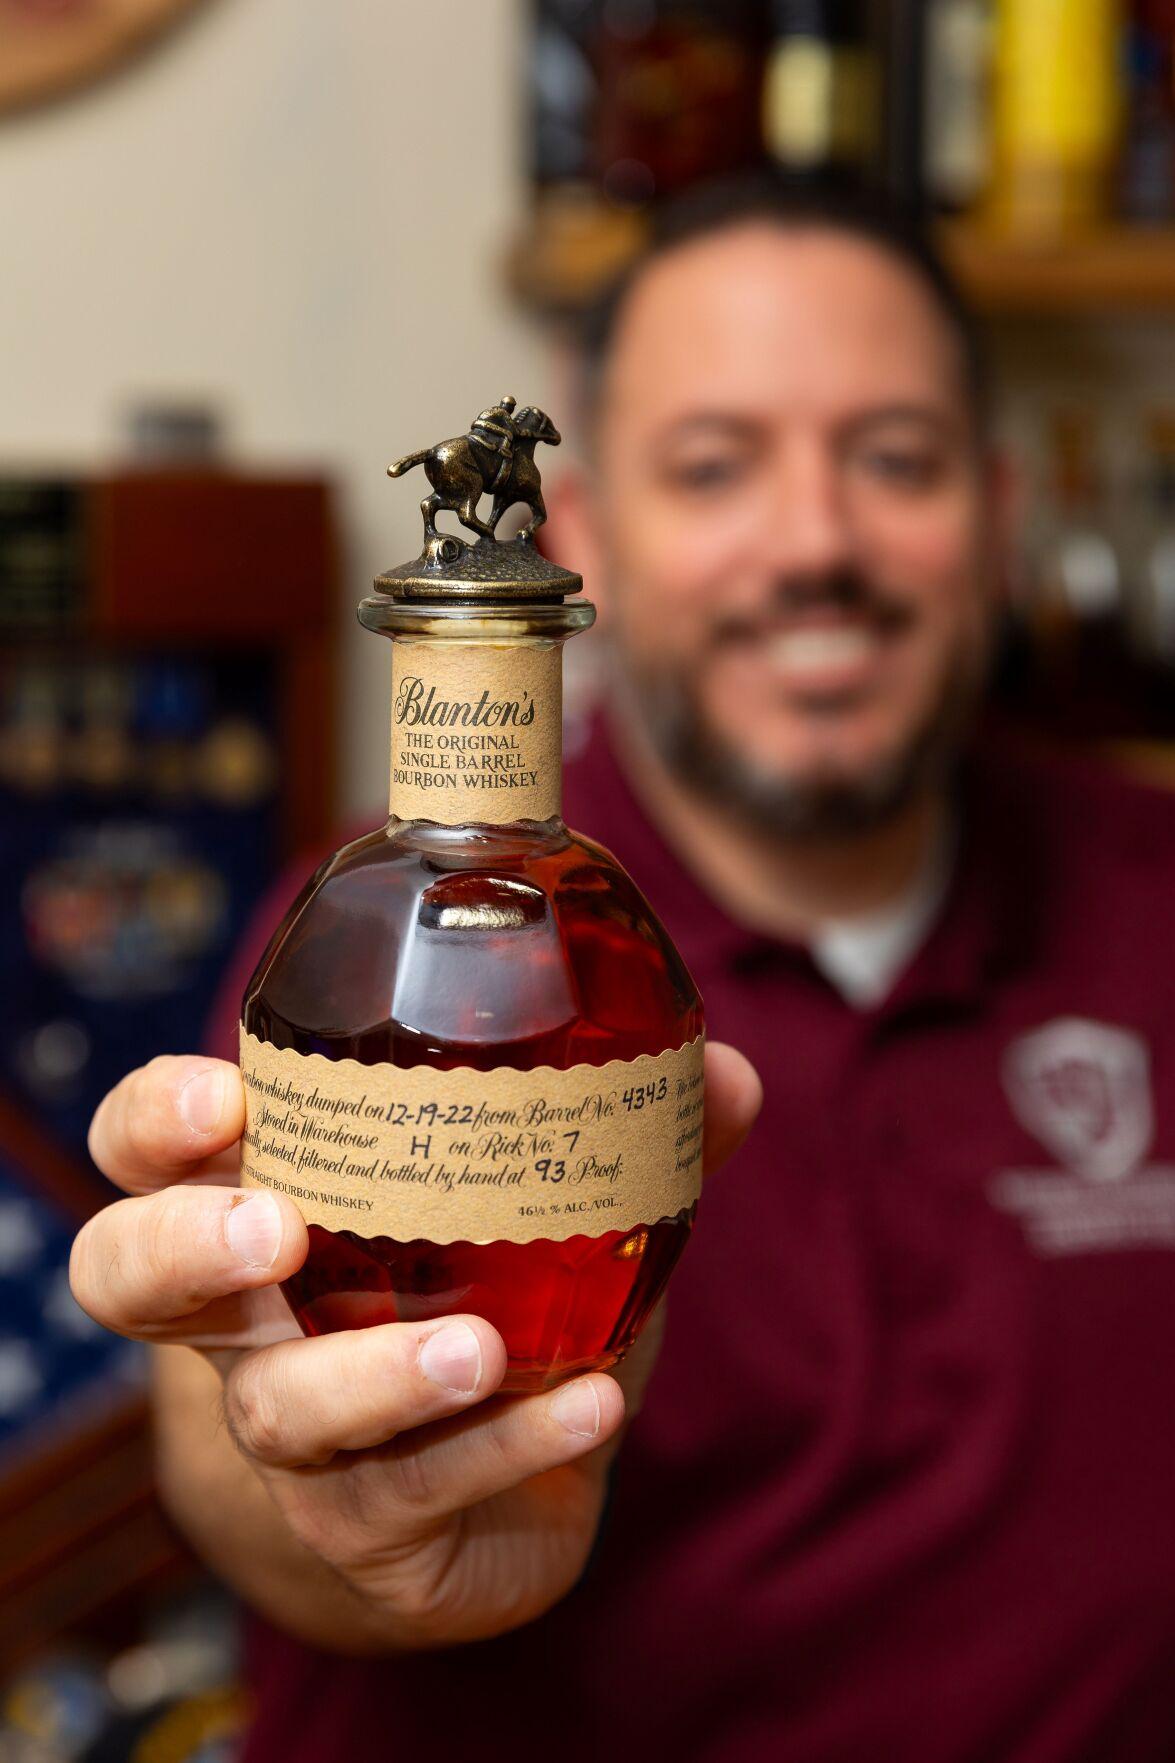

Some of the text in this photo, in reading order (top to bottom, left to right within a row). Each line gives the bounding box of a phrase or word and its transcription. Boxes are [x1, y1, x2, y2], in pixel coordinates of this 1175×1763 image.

[395, 676, 534, 726] Blanton's
[400, 752, 525, 772] SINGLE BARREL
[405, 733, 519, 753] THE ORIGINAL
[394, 769, 538, 790] BOURBON WHISKEY
[265, 1077, 305, 1112] whiskey
[305, 1087, 366, 1119] dumped
[365, 1104, 385, 1122] on
[386, 1103, 473, 1126] 12-19-22
[471, 1101, 516, 1133] from
[516, 1097, 590, 1126] Barrel
[622, 1077, 668, 1112] 4343
[253, 1102, 289, 1134] Stored
[287, 1116, 299, 1139] in
[296, 1113, 379, 1149] Warehouse
[410, 1134, 432, 1159] H
[448, 1141, 471, 1156] on
[470, 1131, 525, 1161] Rick
[562, 1131, 580, 1153] 7
[297, 1146, 347, 1174] filtered
[346, 1159, 379, 1183] and
[380, 1162, 434, 1187] bottled
[434, 1164, 456, 1193] by
[457, 1164, 510, 1188] hand
[506, 1167, 527, 1187] at
[535, 1159, 565, 1183] 93
[273, 1179, 318, 1201] BOURBON
[320, 1192, 374, 1211] WHISKEY
